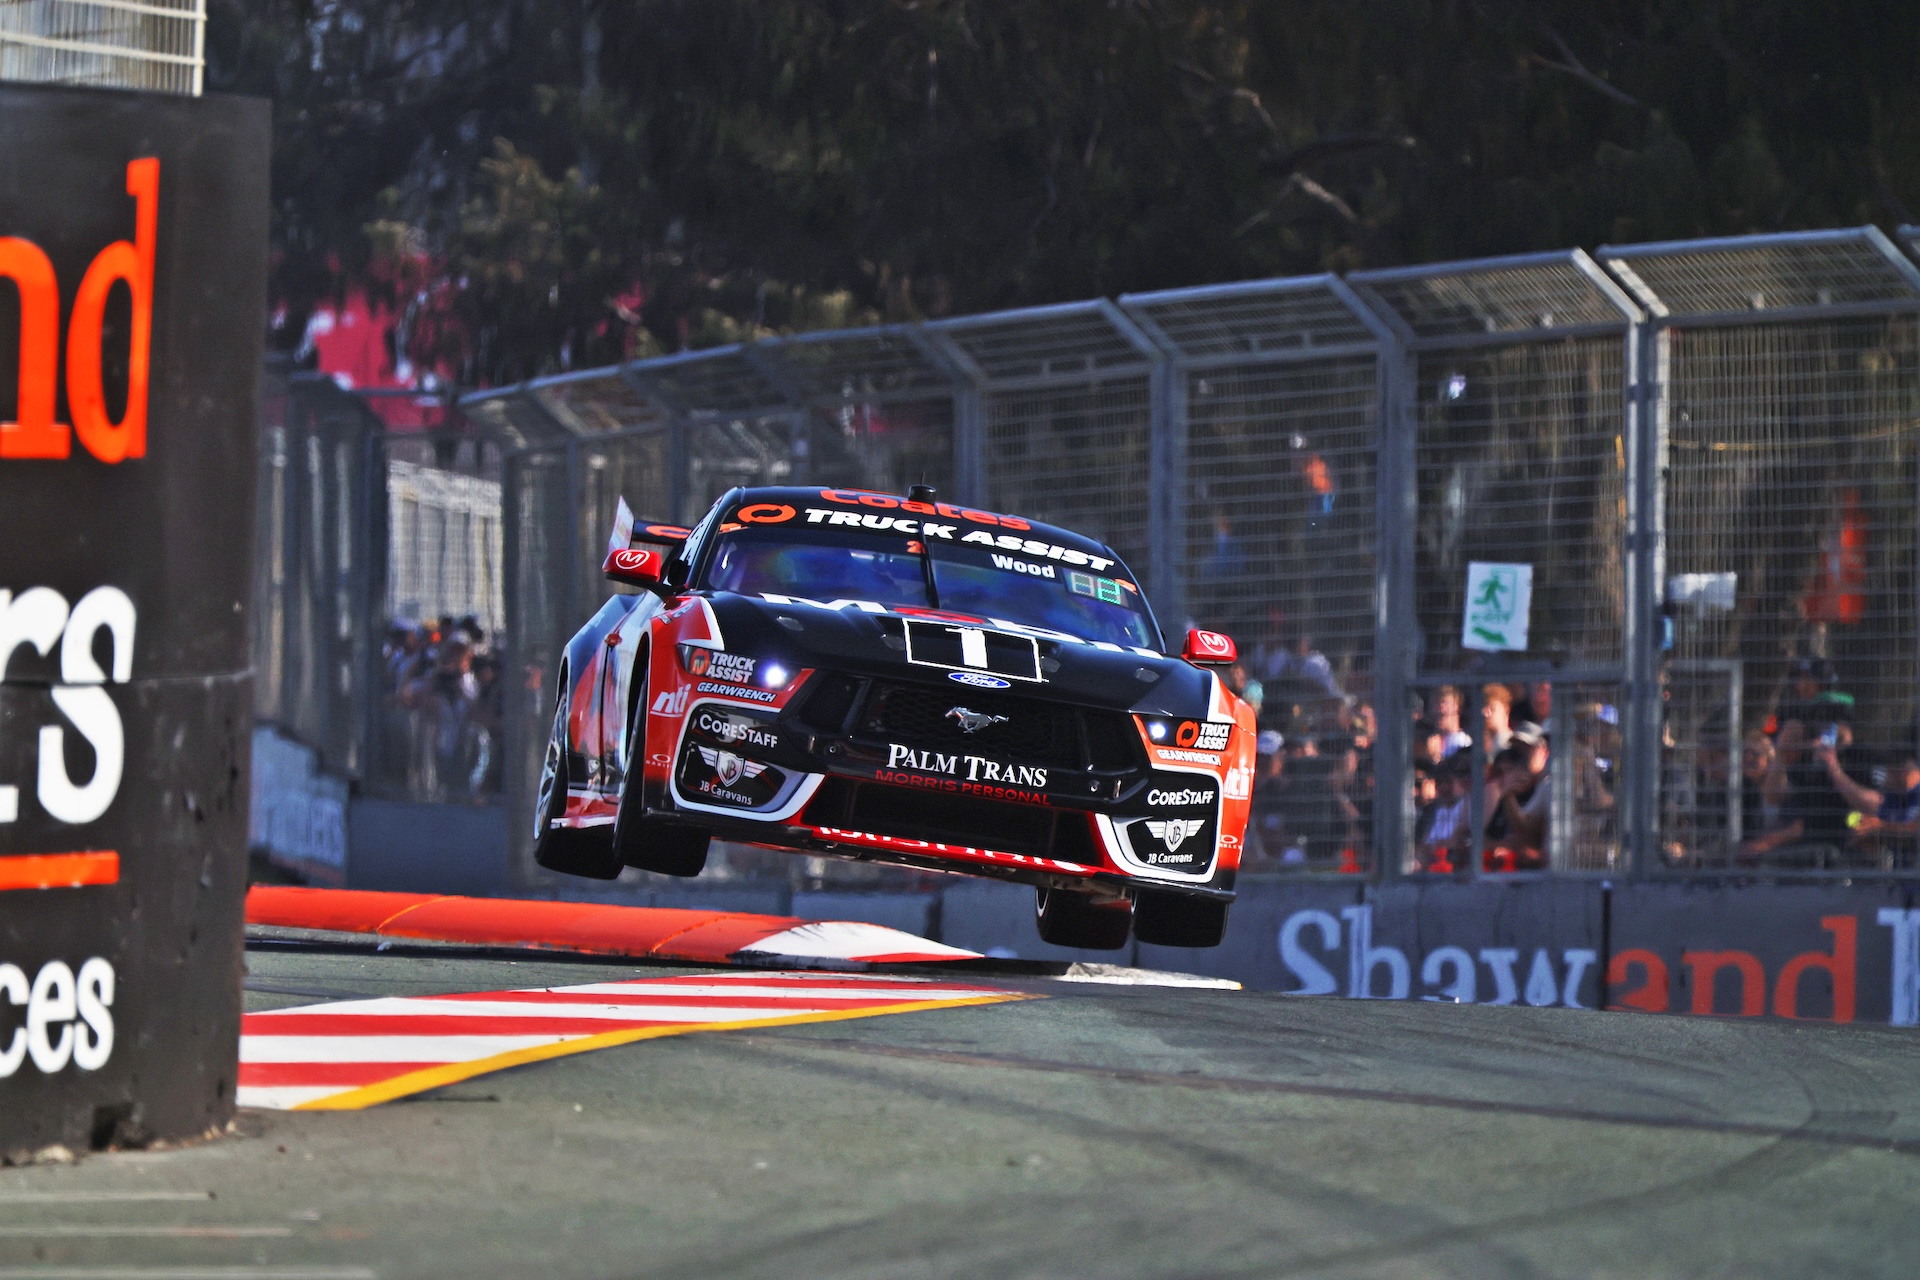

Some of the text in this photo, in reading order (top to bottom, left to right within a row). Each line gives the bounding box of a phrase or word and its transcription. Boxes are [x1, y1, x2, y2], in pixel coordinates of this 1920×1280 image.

[804, 508, 1115, 572] TRUCK ASSIST
[991, 553, 1056, 579] Wood
[712, 652, 756, 671] TRUCK
[706, 665, 752, 684] ASSIST
[652, 684, 692, 714] nti
[697, 682, 776, 702] GEARWRENCH
[1200, 723, 1230, 737] TRUCK
[1193, 736, 1228, 750] ASSIST
[886, 743, 1048, 788] PALM TRANS
[1156, 749, 1222, 766] GEARWRENCH
[700, 780, 753, 805] JB Caravans
[875, 769, 1050, 805] MORRIS PERSONAL
[1147, 853, 1194, 864] JB Caravans
[1278, 905, 1597, 1010] Shaw
[1606, 915, 1858, 1024] and
